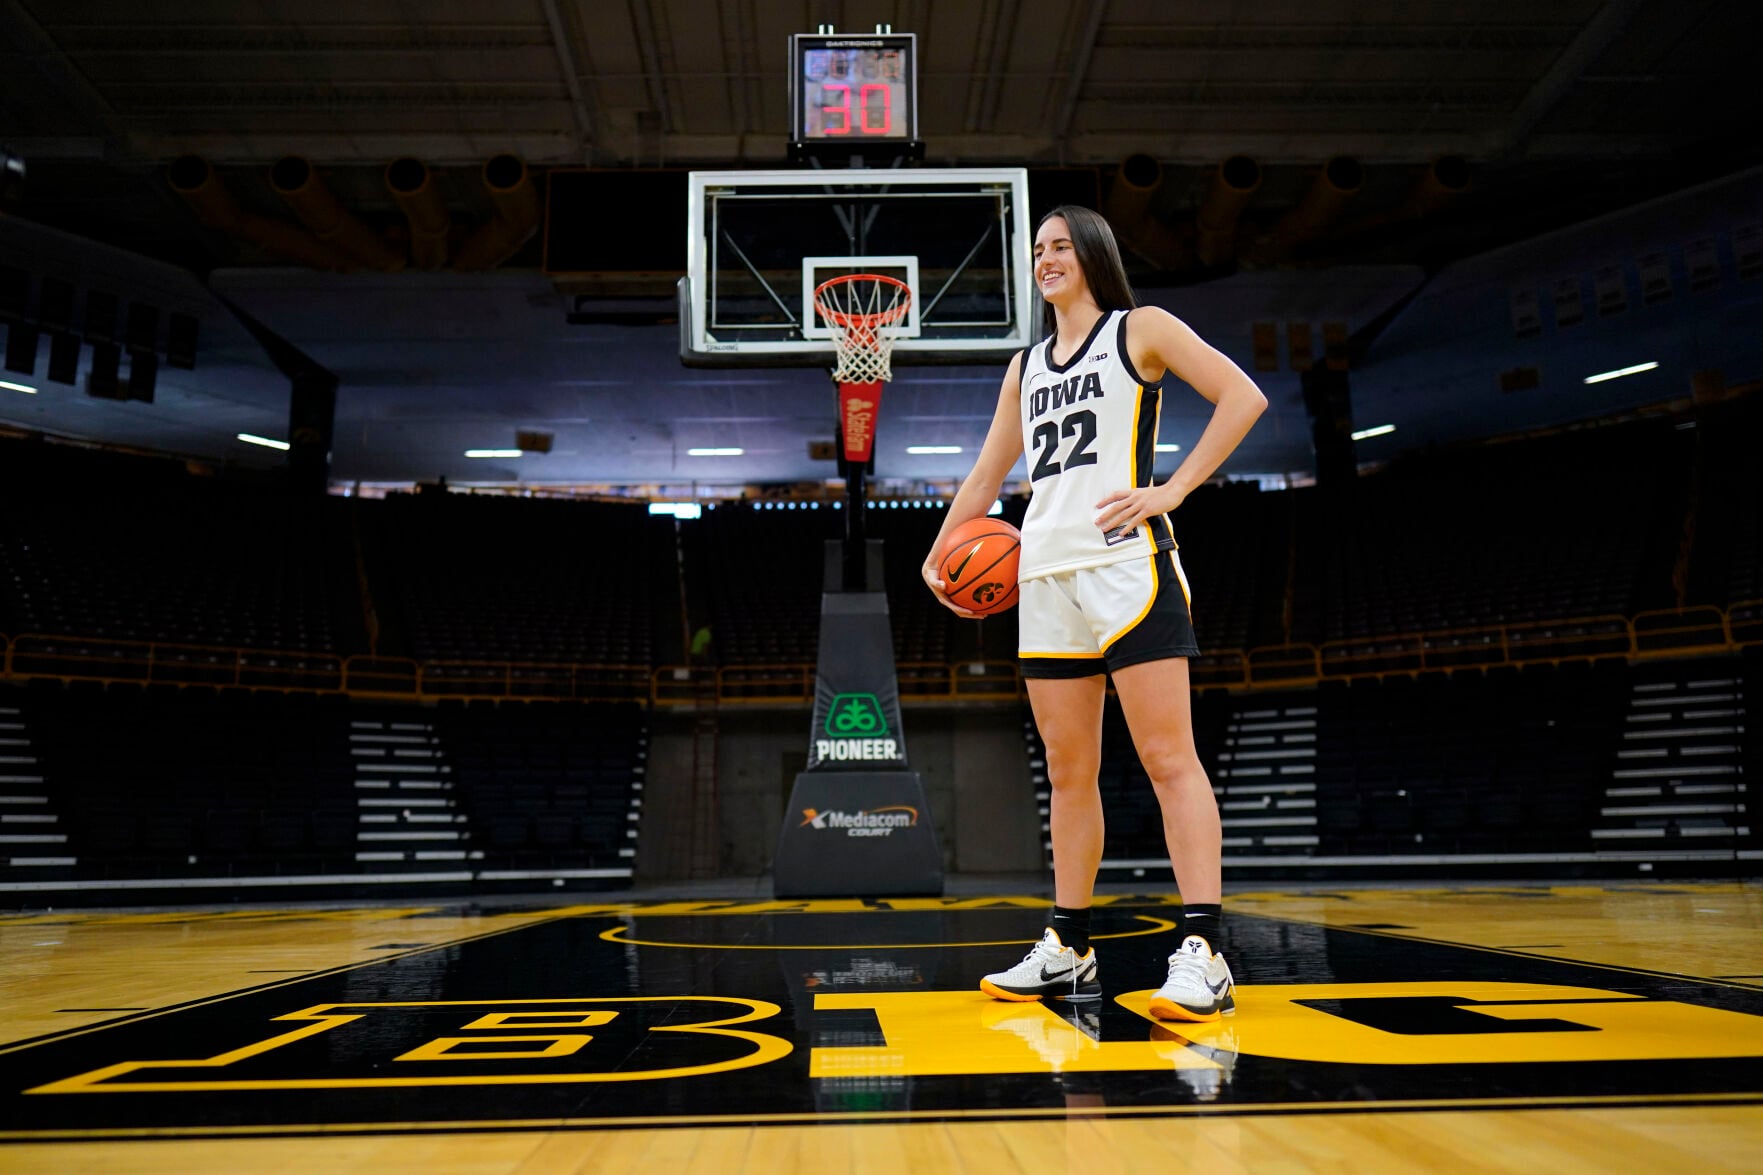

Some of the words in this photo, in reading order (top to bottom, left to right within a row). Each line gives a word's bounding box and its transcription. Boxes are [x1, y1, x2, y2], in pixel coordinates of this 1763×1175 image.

[822, 84, 891, 134] 30
[1029, 371, 1105, 423] IOWA
[1031, 409, 1098, 483] 22
[816, 739, 897, 760] PIONEER
[829, 810, 911, 828] Mediacom
[847, 828, 893, 837] COURT
